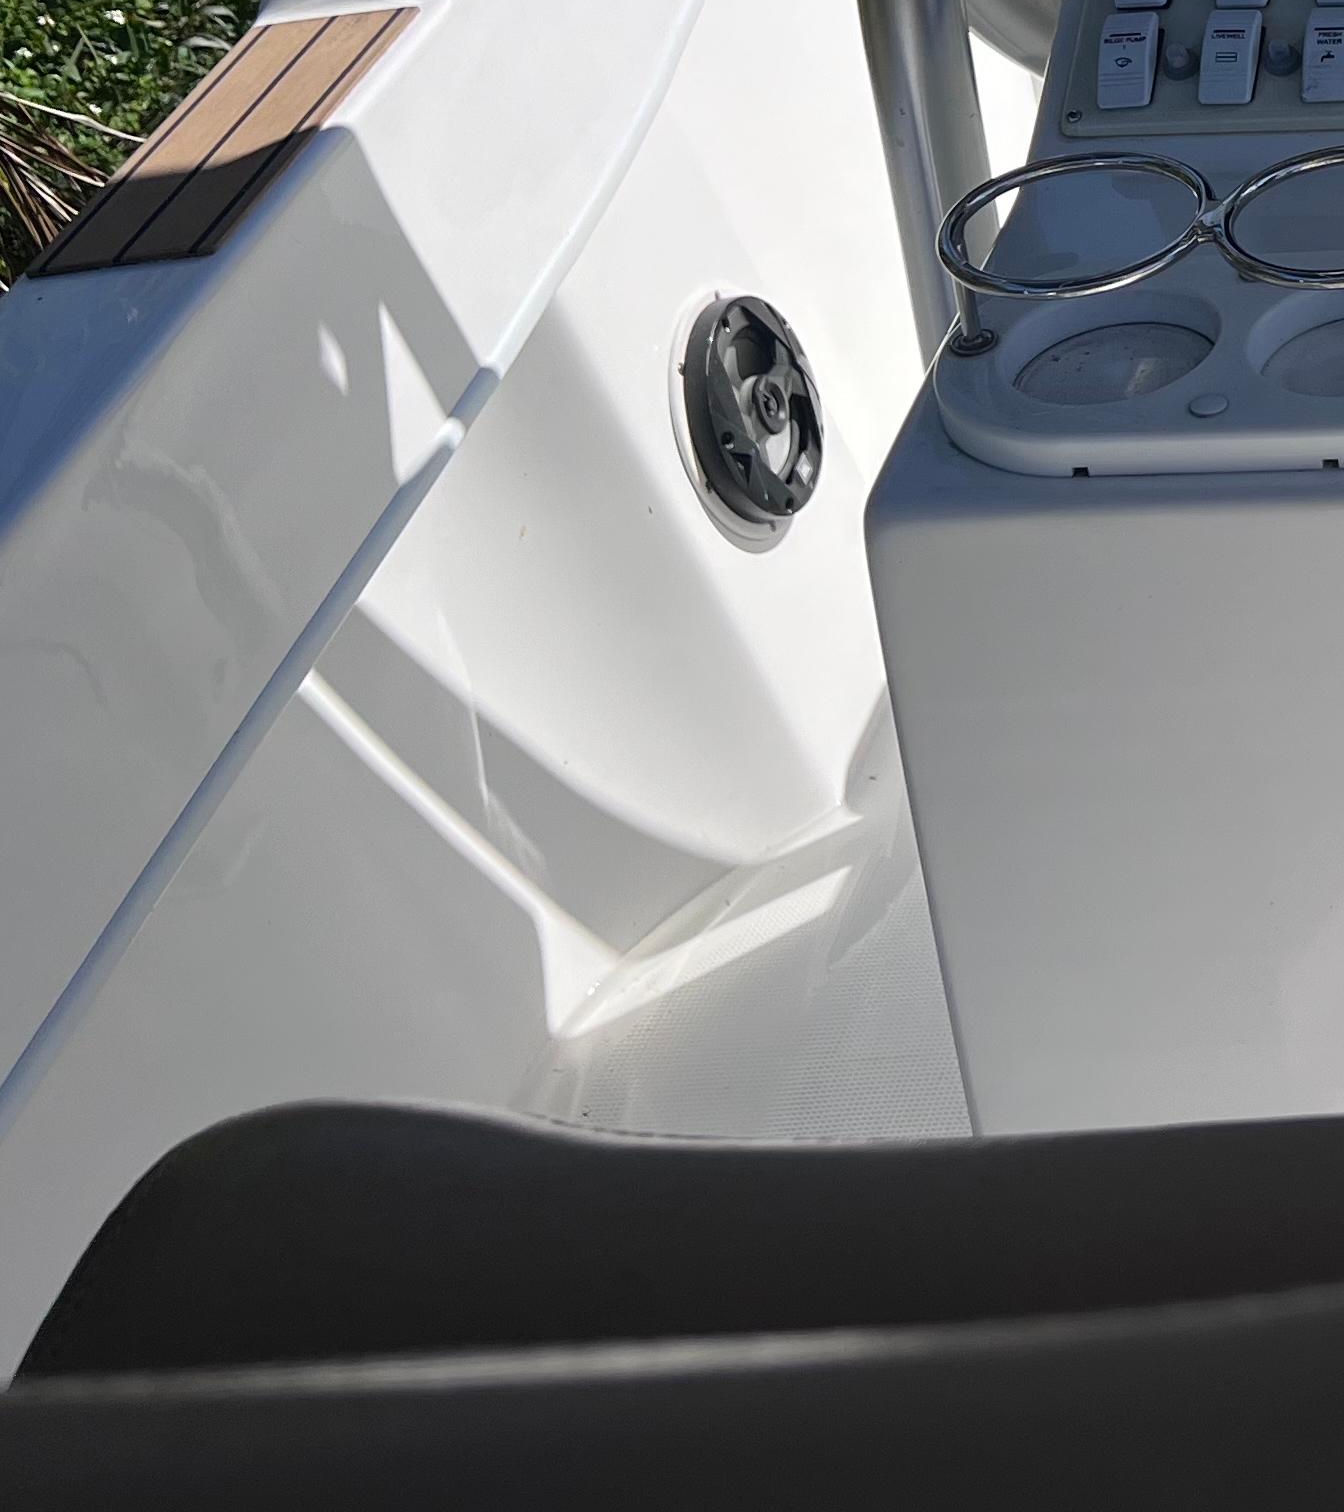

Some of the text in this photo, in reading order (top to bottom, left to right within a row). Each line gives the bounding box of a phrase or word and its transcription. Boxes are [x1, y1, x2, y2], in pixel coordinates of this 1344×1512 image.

[1210, 32, 1247, 40] LIVEWELL
[1318, 30, 1343, 38] FRESH
[1125, 35, 1147, 44] PUMP
